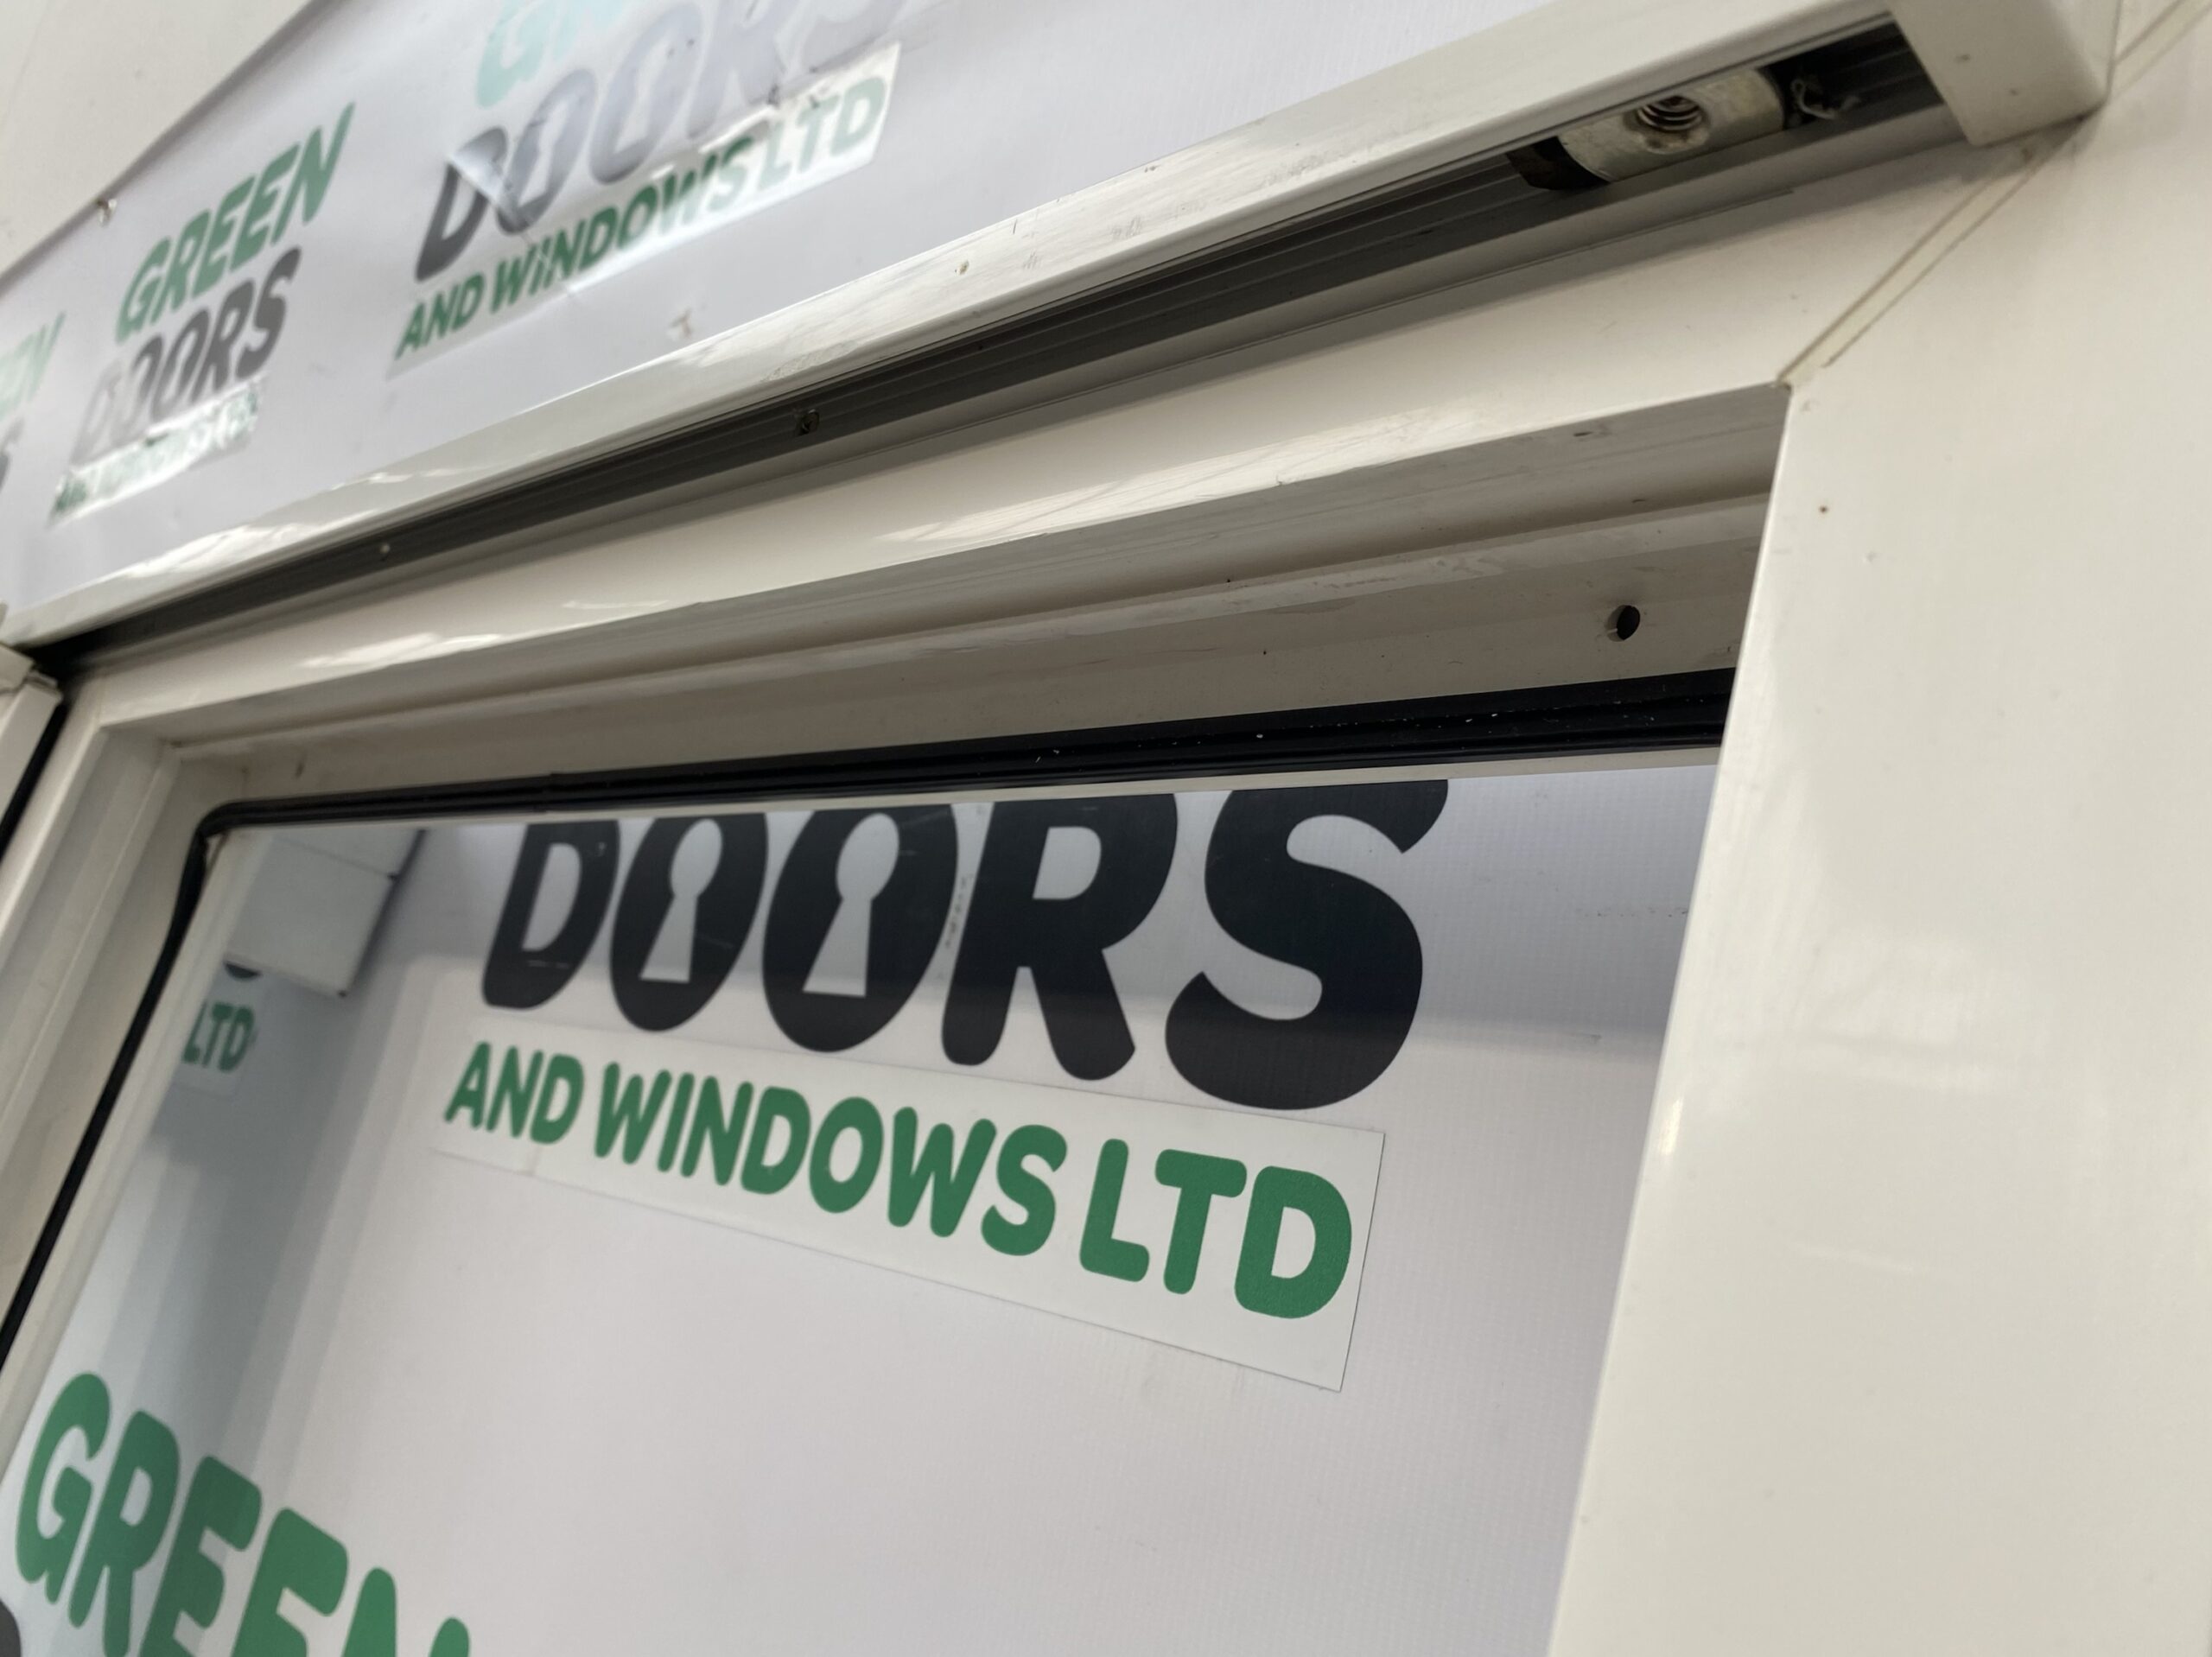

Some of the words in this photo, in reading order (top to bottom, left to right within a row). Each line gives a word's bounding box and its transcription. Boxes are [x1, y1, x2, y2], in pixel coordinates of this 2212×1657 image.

[115, 102, 355, 345] GREEN
[395, 271, 487, 361] AND
[489, 136, 754, 315] WINDOWS
[758, 75, 887, 191] LTD
[70, 245, 302, 468] DOORS
[181, 1000, 256, 1074] LTD
[481, 779, 1449, 1110] DOORS
[444, 1041, 584, 1144] AND
[594, 1061, 1068, 1257] WINDOWS
[1079, 1138, 1353, 1320] LTD
